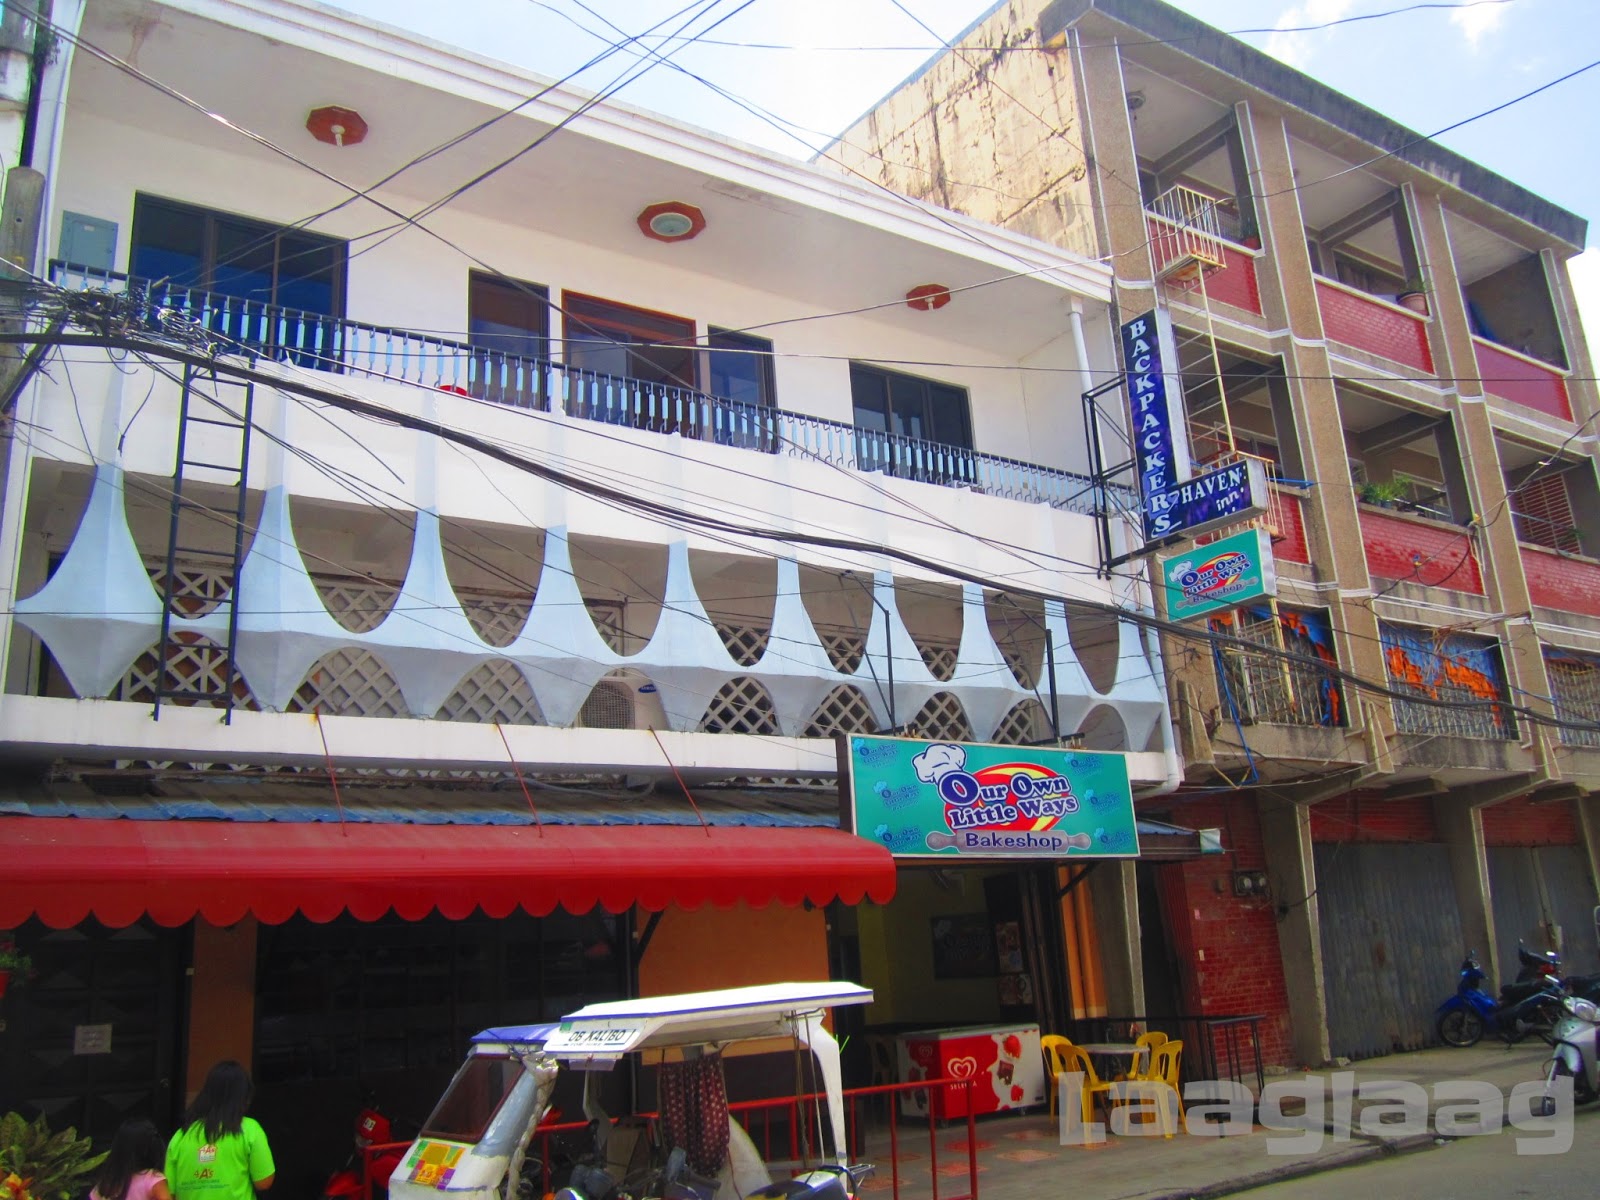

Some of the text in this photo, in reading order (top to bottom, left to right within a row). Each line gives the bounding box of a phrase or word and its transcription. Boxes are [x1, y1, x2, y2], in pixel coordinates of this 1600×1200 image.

[1130, 319, 1171, 533] BACKPACKERS
[1181, 467, 1241, 504] HAVEN
[1216, 490, 1240, 511] inn
[1181, 553, 1247, 588] Our Own
[1185, 562, 1251, 598] Little Ways
[941, 771, 1070, 805] Our Own
[949, 804, 1018, 828] Little
[1017, 796, 1078, 818] Ways
[965, 832, 1063, 851] Bakeshop
[584, 1029, 626, 1042] KALIBO
[950, 1080, 977, 1090] SELEA
